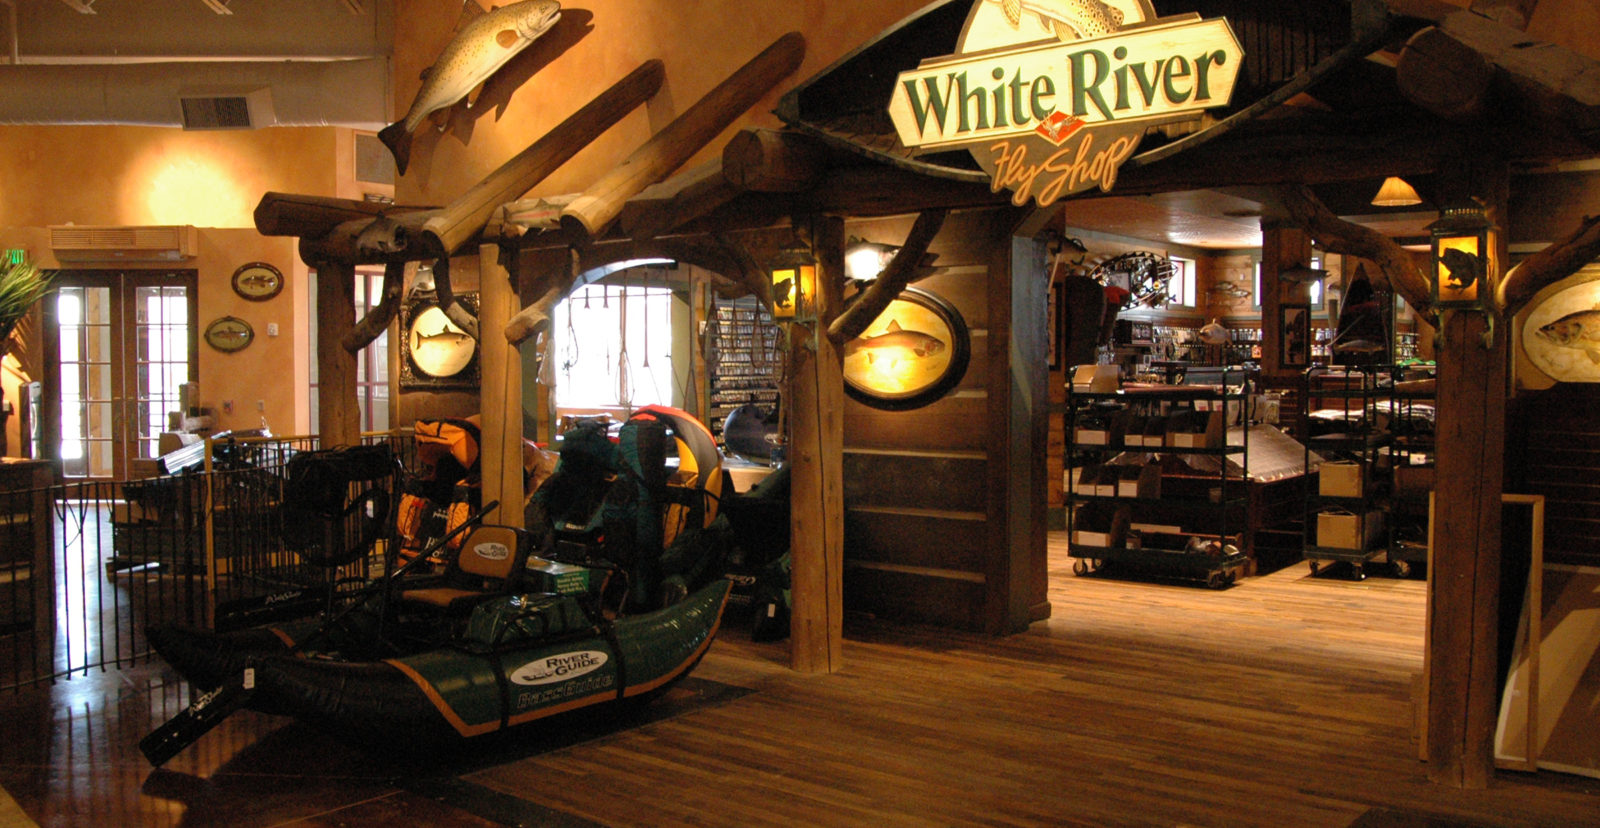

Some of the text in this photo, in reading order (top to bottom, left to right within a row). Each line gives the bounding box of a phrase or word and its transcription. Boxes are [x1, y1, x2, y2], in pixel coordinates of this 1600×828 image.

[902, 46, 1227, 140] White River
[990, 134, 1139, 207] Fly Shop
[546, 652, 590, 668] RIVER
[555, 657, 600, 676] GUIDE
